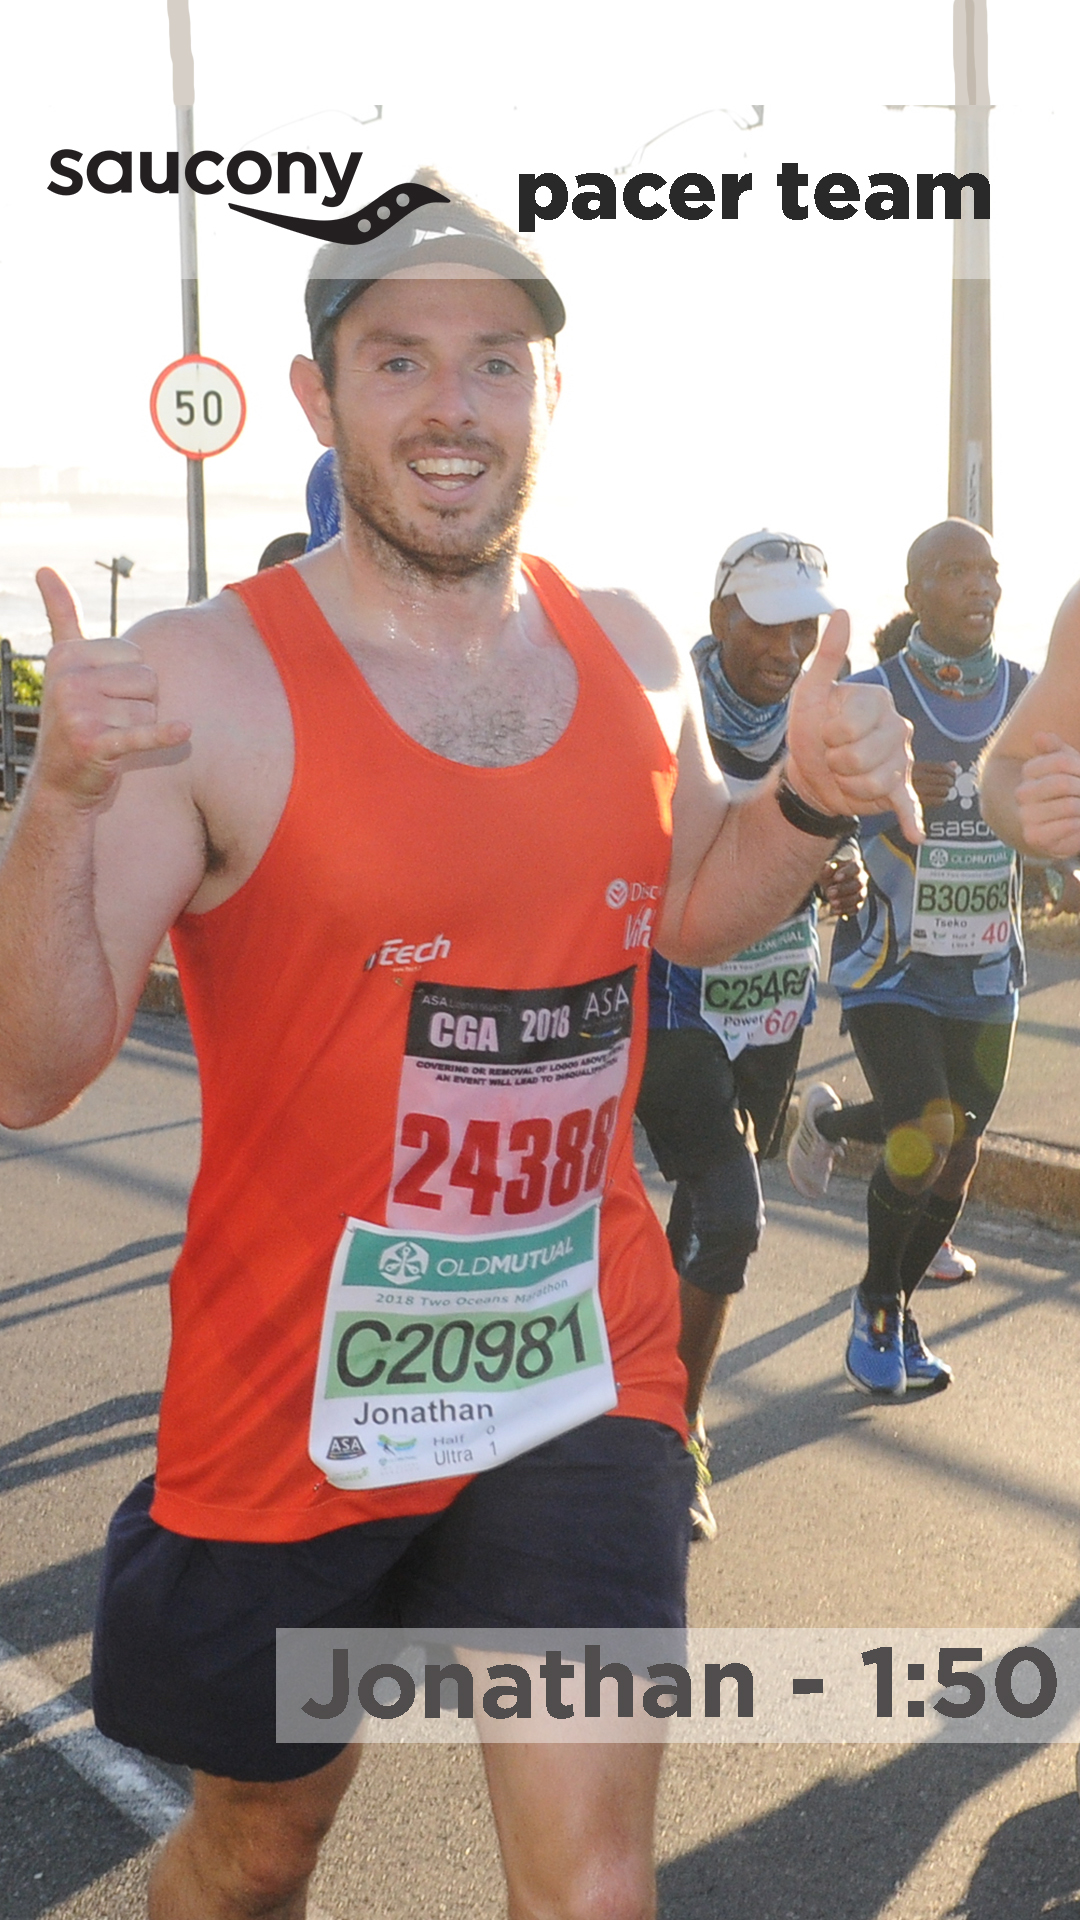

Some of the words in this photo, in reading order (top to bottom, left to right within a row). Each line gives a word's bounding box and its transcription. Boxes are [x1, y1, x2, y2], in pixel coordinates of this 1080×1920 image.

[175, 390, 222, 427] 50
[930, 820, 997, 837] saso
[630, 882, 662, 901] Disc
[917, 880, 1009, 913] B30563
[935, 917, 967, 928] Tseko
[981, 921, 1009, 944] 40
[422, 995, 448, 1007] ASA
[583, 984, 630, 1020] ASA
[429, 1011, 499, 1052] CGA
[520, 1005, 570, 1043] 2018
[724, 1014, 764, 1027] Power
[765, 1009, 798, 1035] 60
[416, 1061, 469, 1074] COVERING
[472, 1067, 486, 1075] OR
[488, 1067, 533, 1076] REMOVAL
[436, 1074, 451, 1082] AN
[453, 1076, 486, 1086] EVENT
[489, 1078, 512, 1086] WILL
[515, 1077, 539, 1085] LEAD
[541, 1075, 553, 1083] TO
[393, 1096, 618, 1216] 24388
[436, 1236, 574, 1277] OLDMUTUAL
[376, 1293, 414, 1306] 2018
[420, 1297, 451, 1307] Two
[456, 1296, 508, 1306] Oceans
[514, 1279, 569, 1305] Marathon
[337, 1302, 587, 1388] C20981
[353, 1399, 494, 1426] Jonathan
[332, 1437, 361, 1451] ASA
[433, 1434, 465, 1446] Half
[434, 1448, 474, 1467] Ultra
[489, 1441, 497, 1456] 1
